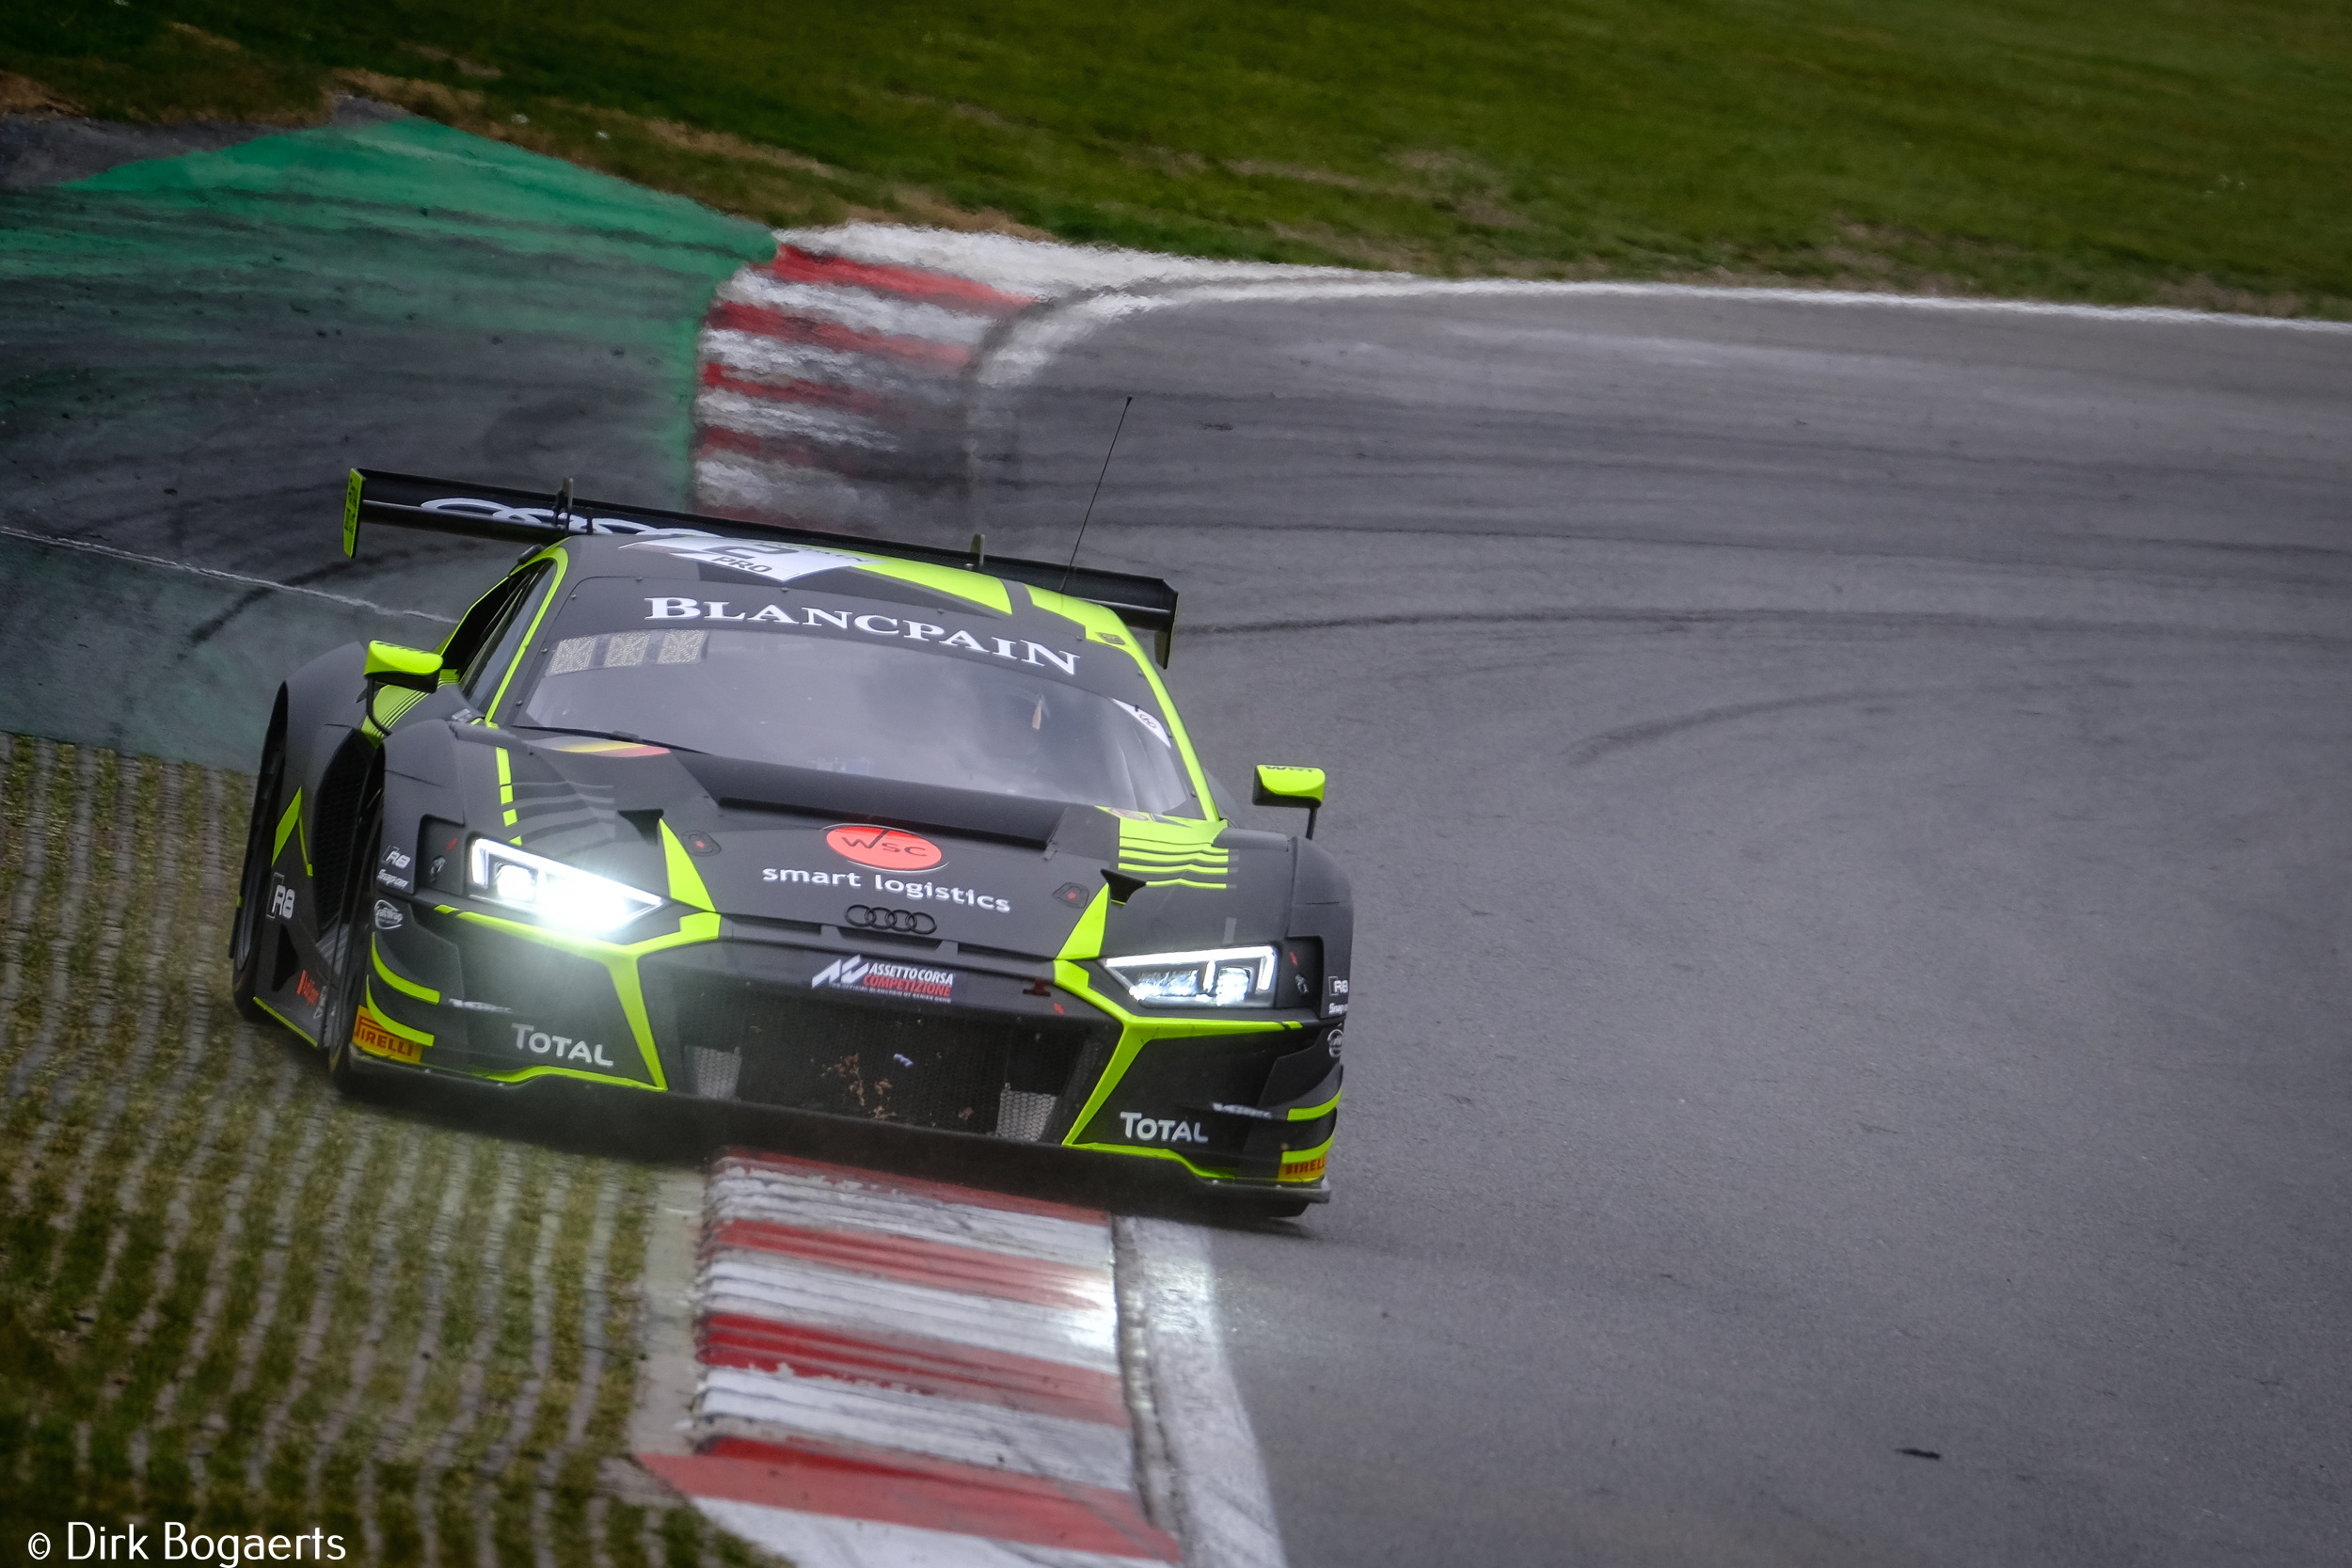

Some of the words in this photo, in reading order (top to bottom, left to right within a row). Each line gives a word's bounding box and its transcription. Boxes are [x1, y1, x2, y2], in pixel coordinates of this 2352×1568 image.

[710, 556, 773, 573] PRO
[840, 828, 928, 857] WSC
[272, 884, 295, 919] R8
[762, 867, 862, 887] smart
[875, 874, 1011, 912] logistics
[863, 974, 953, 997] COMPETIZIONE
[355, 1015, 414, 1057] PIRELLI
[511, 1022, 613, 1067] TOTAL
[1120, 1112, 1209, 1144] TOTAL
